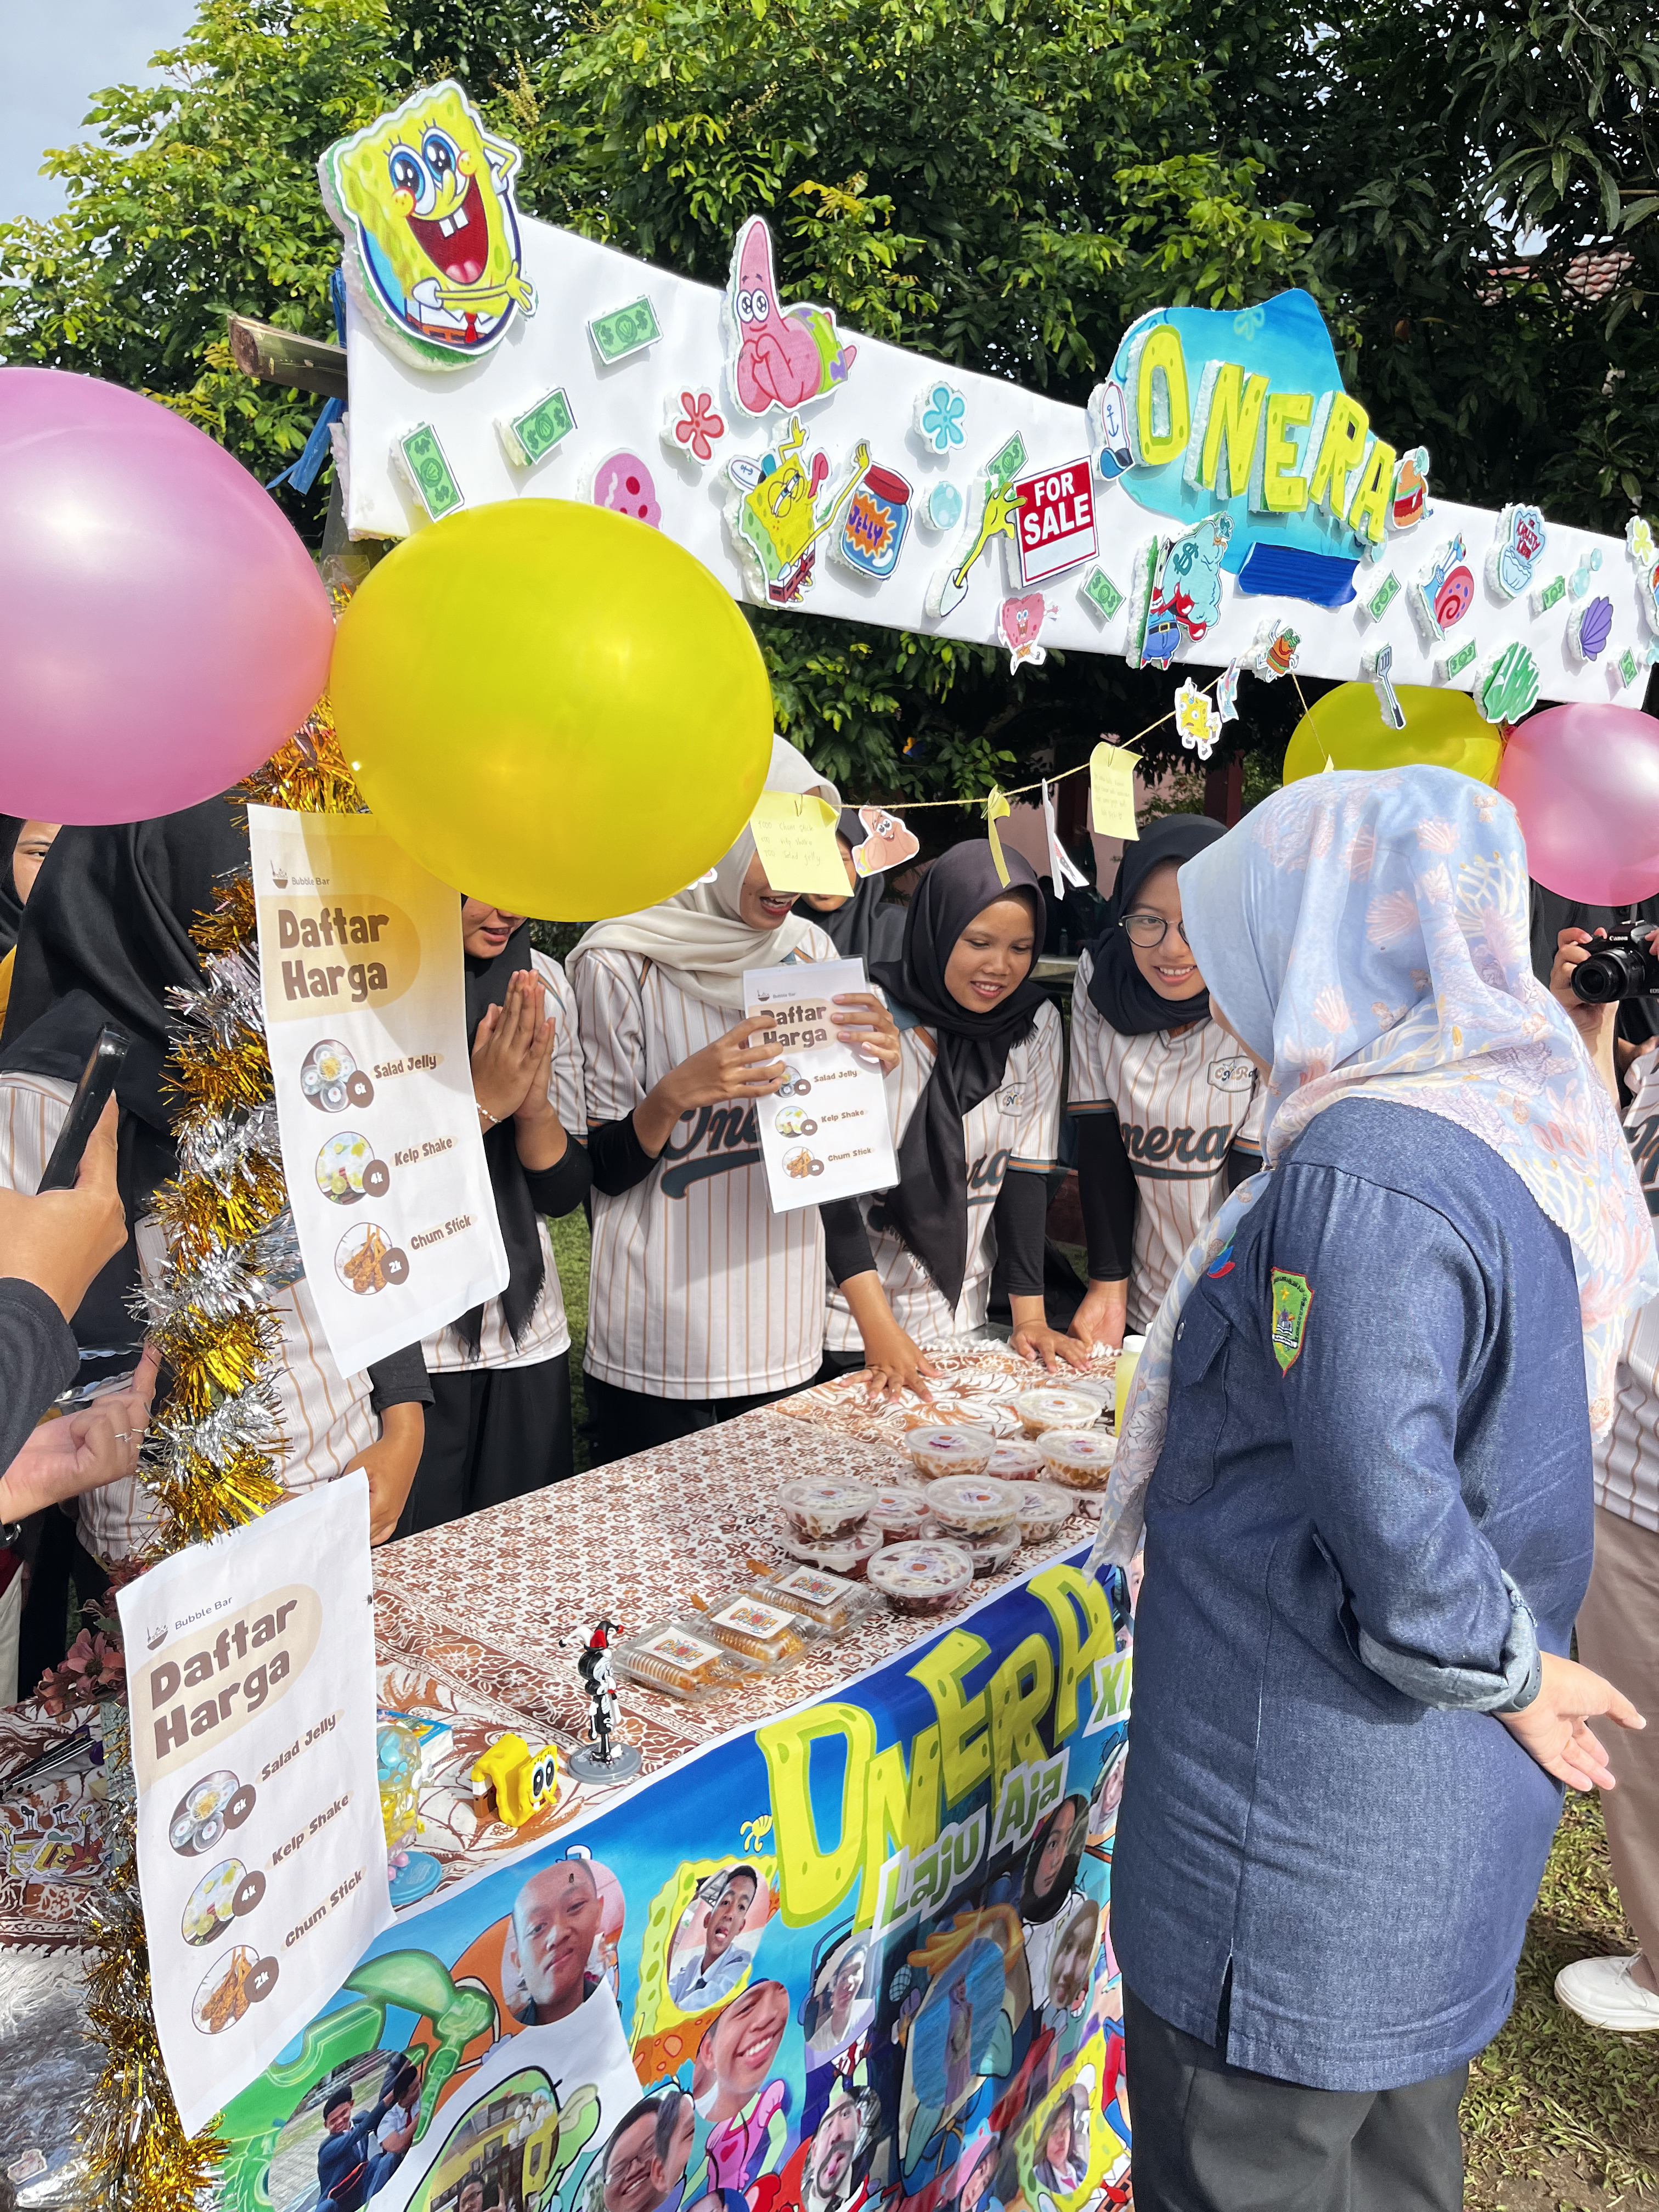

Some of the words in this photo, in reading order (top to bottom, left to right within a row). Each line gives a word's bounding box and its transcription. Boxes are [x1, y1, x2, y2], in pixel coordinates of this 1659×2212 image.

[1135, 324, 1397, 543] ONERA
[1034, 472, 1075, 507] FOR
[848, 505, 884, 547] JELLY
[1024, 493, 1091, 545] SALE
[291, 877, 315, 886] Bubble
[316, 877, 330, 885] Bar
[278, 907, 390, 949] Daftar
[281, 960, 388, 1003] Harga
[763, 1029, 827, 1048] Harga
[374, 1059, 404, 1079] Salad
[408, 1054, 437, 1071] Jelly
[814, 1072, 836, 1082] Salad
[838, 1070, 857, 1079] Jelly
[354, 1083, 366, 1095] 6k
[821, 1115, 839, 1123] Kelp
[841, 1110, 865, 1120] Shake
[394, 1150, 419, 1167] Kelp
[422, 1137, 453, 1155] Shake
[828, 1153, 850, 1162] Chum
[852, 1147, 872, 1157] Stick
[1120, 1122, 1233, 1164] nera
[370, 1172, 383, 1184] 4k
[411, 1230, 444, 1251] Chum
[445, 1215, 472, 1234] Stick
[388, 1261, 402, 1273] 2k
[174, 1606, 212, 1630] Bubble
[214, 1596, 233, 1610] Bar
[150, 1599, 298, 1711] Daftar
[153, 1650, 290, 1760] Harga
[261, 1741, 301, 1781] Salad
[304, 1714, 337, 1746] Jelly
[755, 1563, 1116, 1936] ONERA
[233, 1797, 247, 1815] 6k
[272, 1832, 304, 1866] Kelp
[309, 1793, 349, 1833] Shake
[880, 1819, 980, 1930] Laju
[996, 1762, 1064, 1844] Aja
[241, 1884, 257, 1903] 4k
[285, 1905, 327, 1948] Chum
[329, 1870, 363, 1906] Stick
[255, 1969, 270, 1989] 2k
